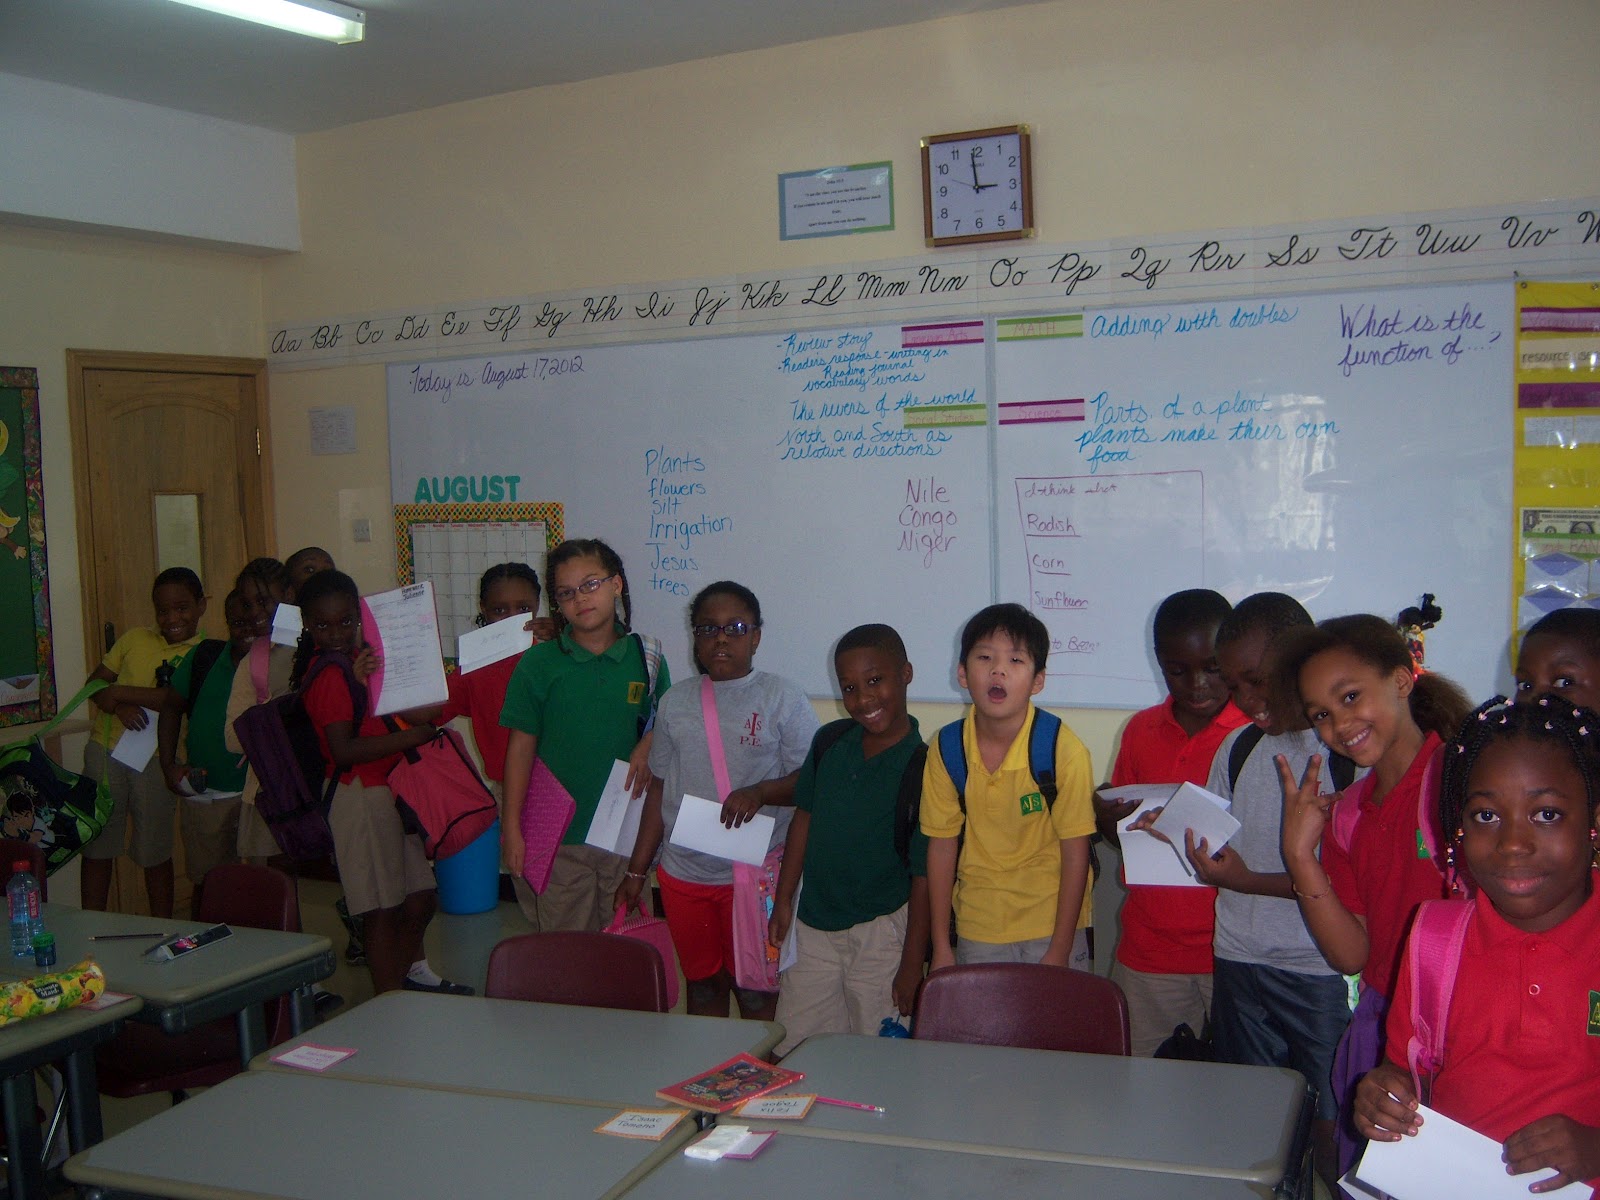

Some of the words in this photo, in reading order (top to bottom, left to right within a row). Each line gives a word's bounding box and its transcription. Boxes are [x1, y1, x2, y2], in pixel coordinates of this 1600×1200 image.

[951, 149, 959, 160] 11
[970, 146, 982, 158] 12
[1008, 156, 1016, 168] 2
[938, 163, 949, 175] 10
[939, 186, 948, 197] 9
[1008, 178, 1017, 190] 3
[940, 208, 948, 219] 8
[1010, 201, 1017, 212] 4
[953, 220, 961, 231] 7
[975, 218, 983, 229] 6
[997, 216, 1005, 227] 5
[271, 329, 302, 354] Aa
[310, 324, 343, 350] Bb
[356, 320, 384, 345] Cc
[395, 316, 430, 342] Dd
[440, 311, 470, 336] Ee
[483, 304, 521, 342] Ff
[533, 302, 572, 338] Gg
[582, 295, 624, 323] Hh
[635, 291, 675, 320] Ii
[688, 286, 731, 326] Jj
[741, 280, 790, 310] Kk
[801, 274, 847, 306] Ll
[856, 271, 910, 300] Mm
[918, 264, 969, 294] Nn
[989, 257, 1028, 288] Oo
[1048, 252, 1102, 296] Pp
[1188, 240, 1246, 273] Rr
[1264, 234, 1320, 268] Ss
[1338, 226, 1398, 261] Tt
[1416, 223, 1482, 256] Uu
[1501, 216, 1560, 248] Vv
[1013, 322, 1057, 337] MATH
[1090, 313, 1171, 341] Adding
[1174, 306, 1221, 334] with
[1229, 302, 1300, 329] doubles
[1340, 303, 1402, 340] What
[1406, 314, 1441, 333] is
[1442, 302, 1486, 332] the
[837, 330, 874, 352] story
[932, 349, 950, 359] in
[1338, 342, 1433, 378] function
[456, 368, 475, 387] is
[482, 360, 530, 390] August
[868, 359, 916, 377] journal
[871, 372, 926, 386] words
[790, 400, 816, 421] The
[874, 392, 890, 419] of
[893, 391, 921, 411] the
[923, 387, 978, 405] world
[776, 427, 826, 446] North
[834, 426, 868, 442] and
[870, 422, 918, 442] South
[926, 429, 953, 443] as
[1074, 425, 1159, 453] plants
[1160, 422, 1218, 443] make
[1228, 418, 1286, 442] their
[1296, 419, 1341, 440] own
[645, 445, 706, 476] Plants
[780, 444, 848, 461] relative
[852, 442, 944, 460] directions
[1086, 447, 1138, 474] food
[414, 475, 521, 504] AUGUST
[648, 478, 706, 498] flowers
[906, 476, 951, 504] Nile
[898, 504, 958, 536] Congo
[649, 516, 734, 550] Irrigation
[644, 542, 700, 572] Jesus
[896, 530, 958, 570] Niger
[1032, 554, 1065, 569] Corn
[648, 576, 690, 597] trees
[740, 736, 762, 748] P.E.
